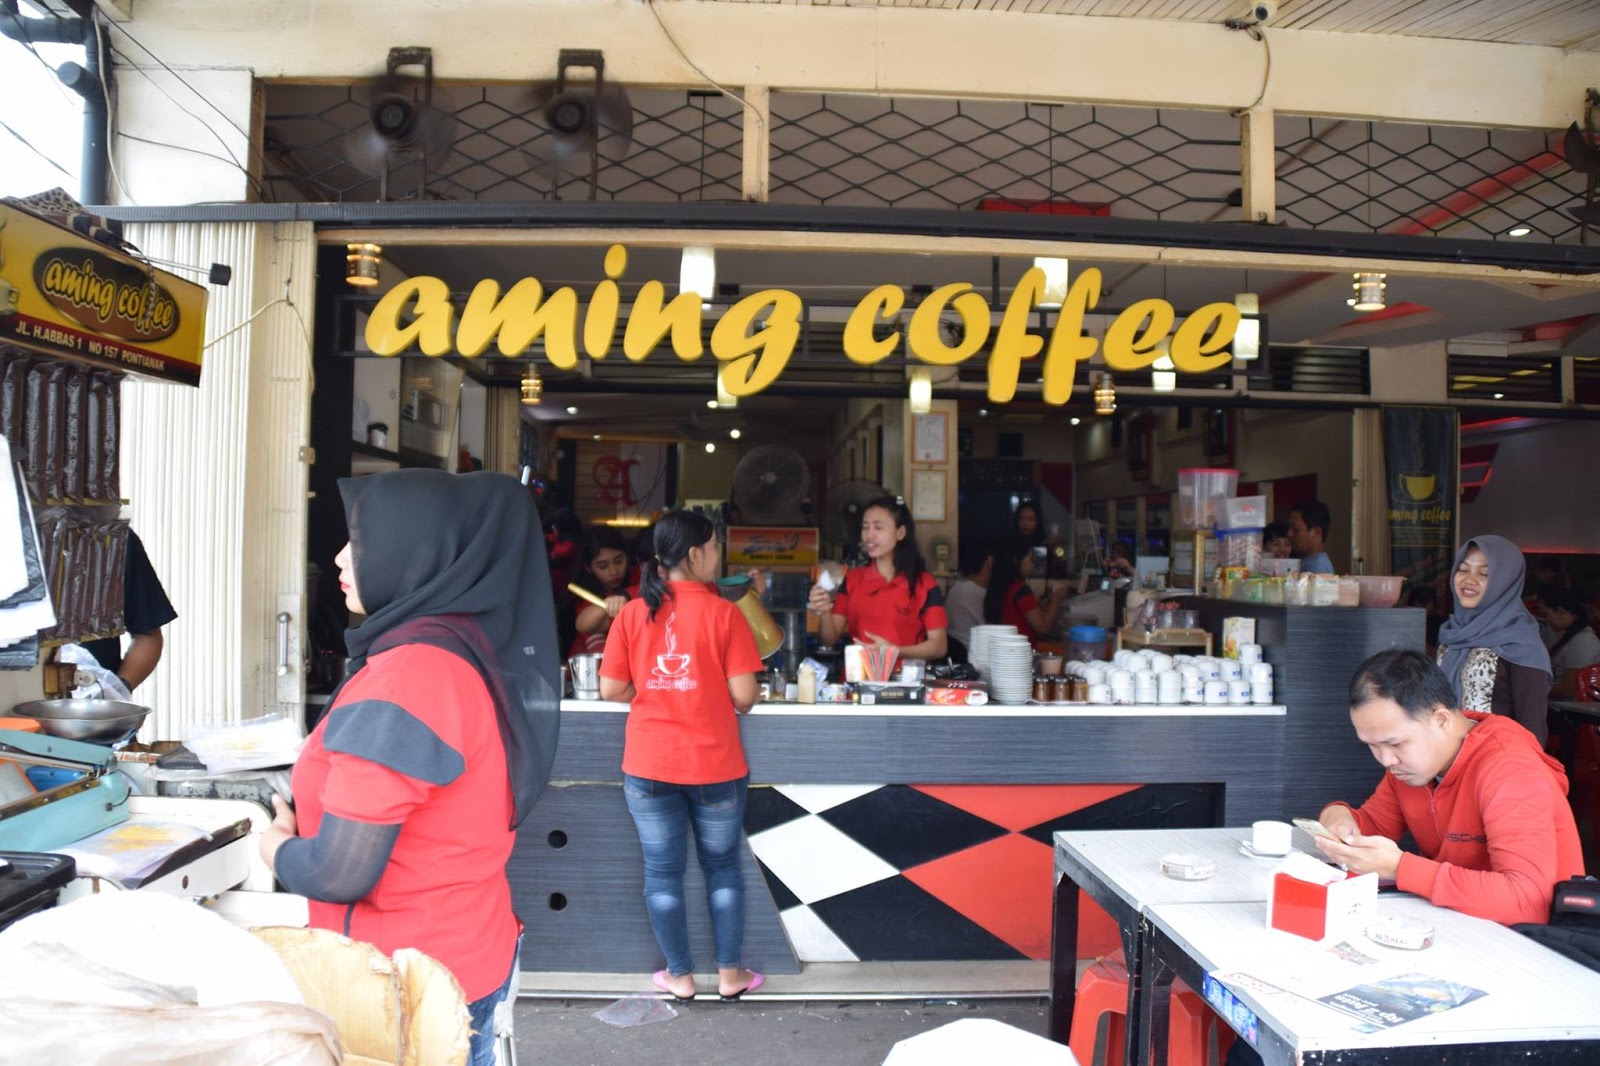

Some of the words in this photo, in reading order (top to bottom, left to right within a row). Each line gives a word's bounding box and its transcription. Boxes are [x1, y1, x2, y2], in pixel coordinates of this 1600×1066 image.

[44, 259, 115, 322] aming
[117, 283, 174, 333] coffee
[365, 244, 803, 397] aming
[843, 267, 1242, 406] coffee
[15, 320, 30, 336] JL.
[33, 324, 75, 347] H.ABBAS
[88, 341, 103, 355] NO
[104, 344, 119, 359] 157
[121, 351, 166, 372] PONTIANAK
